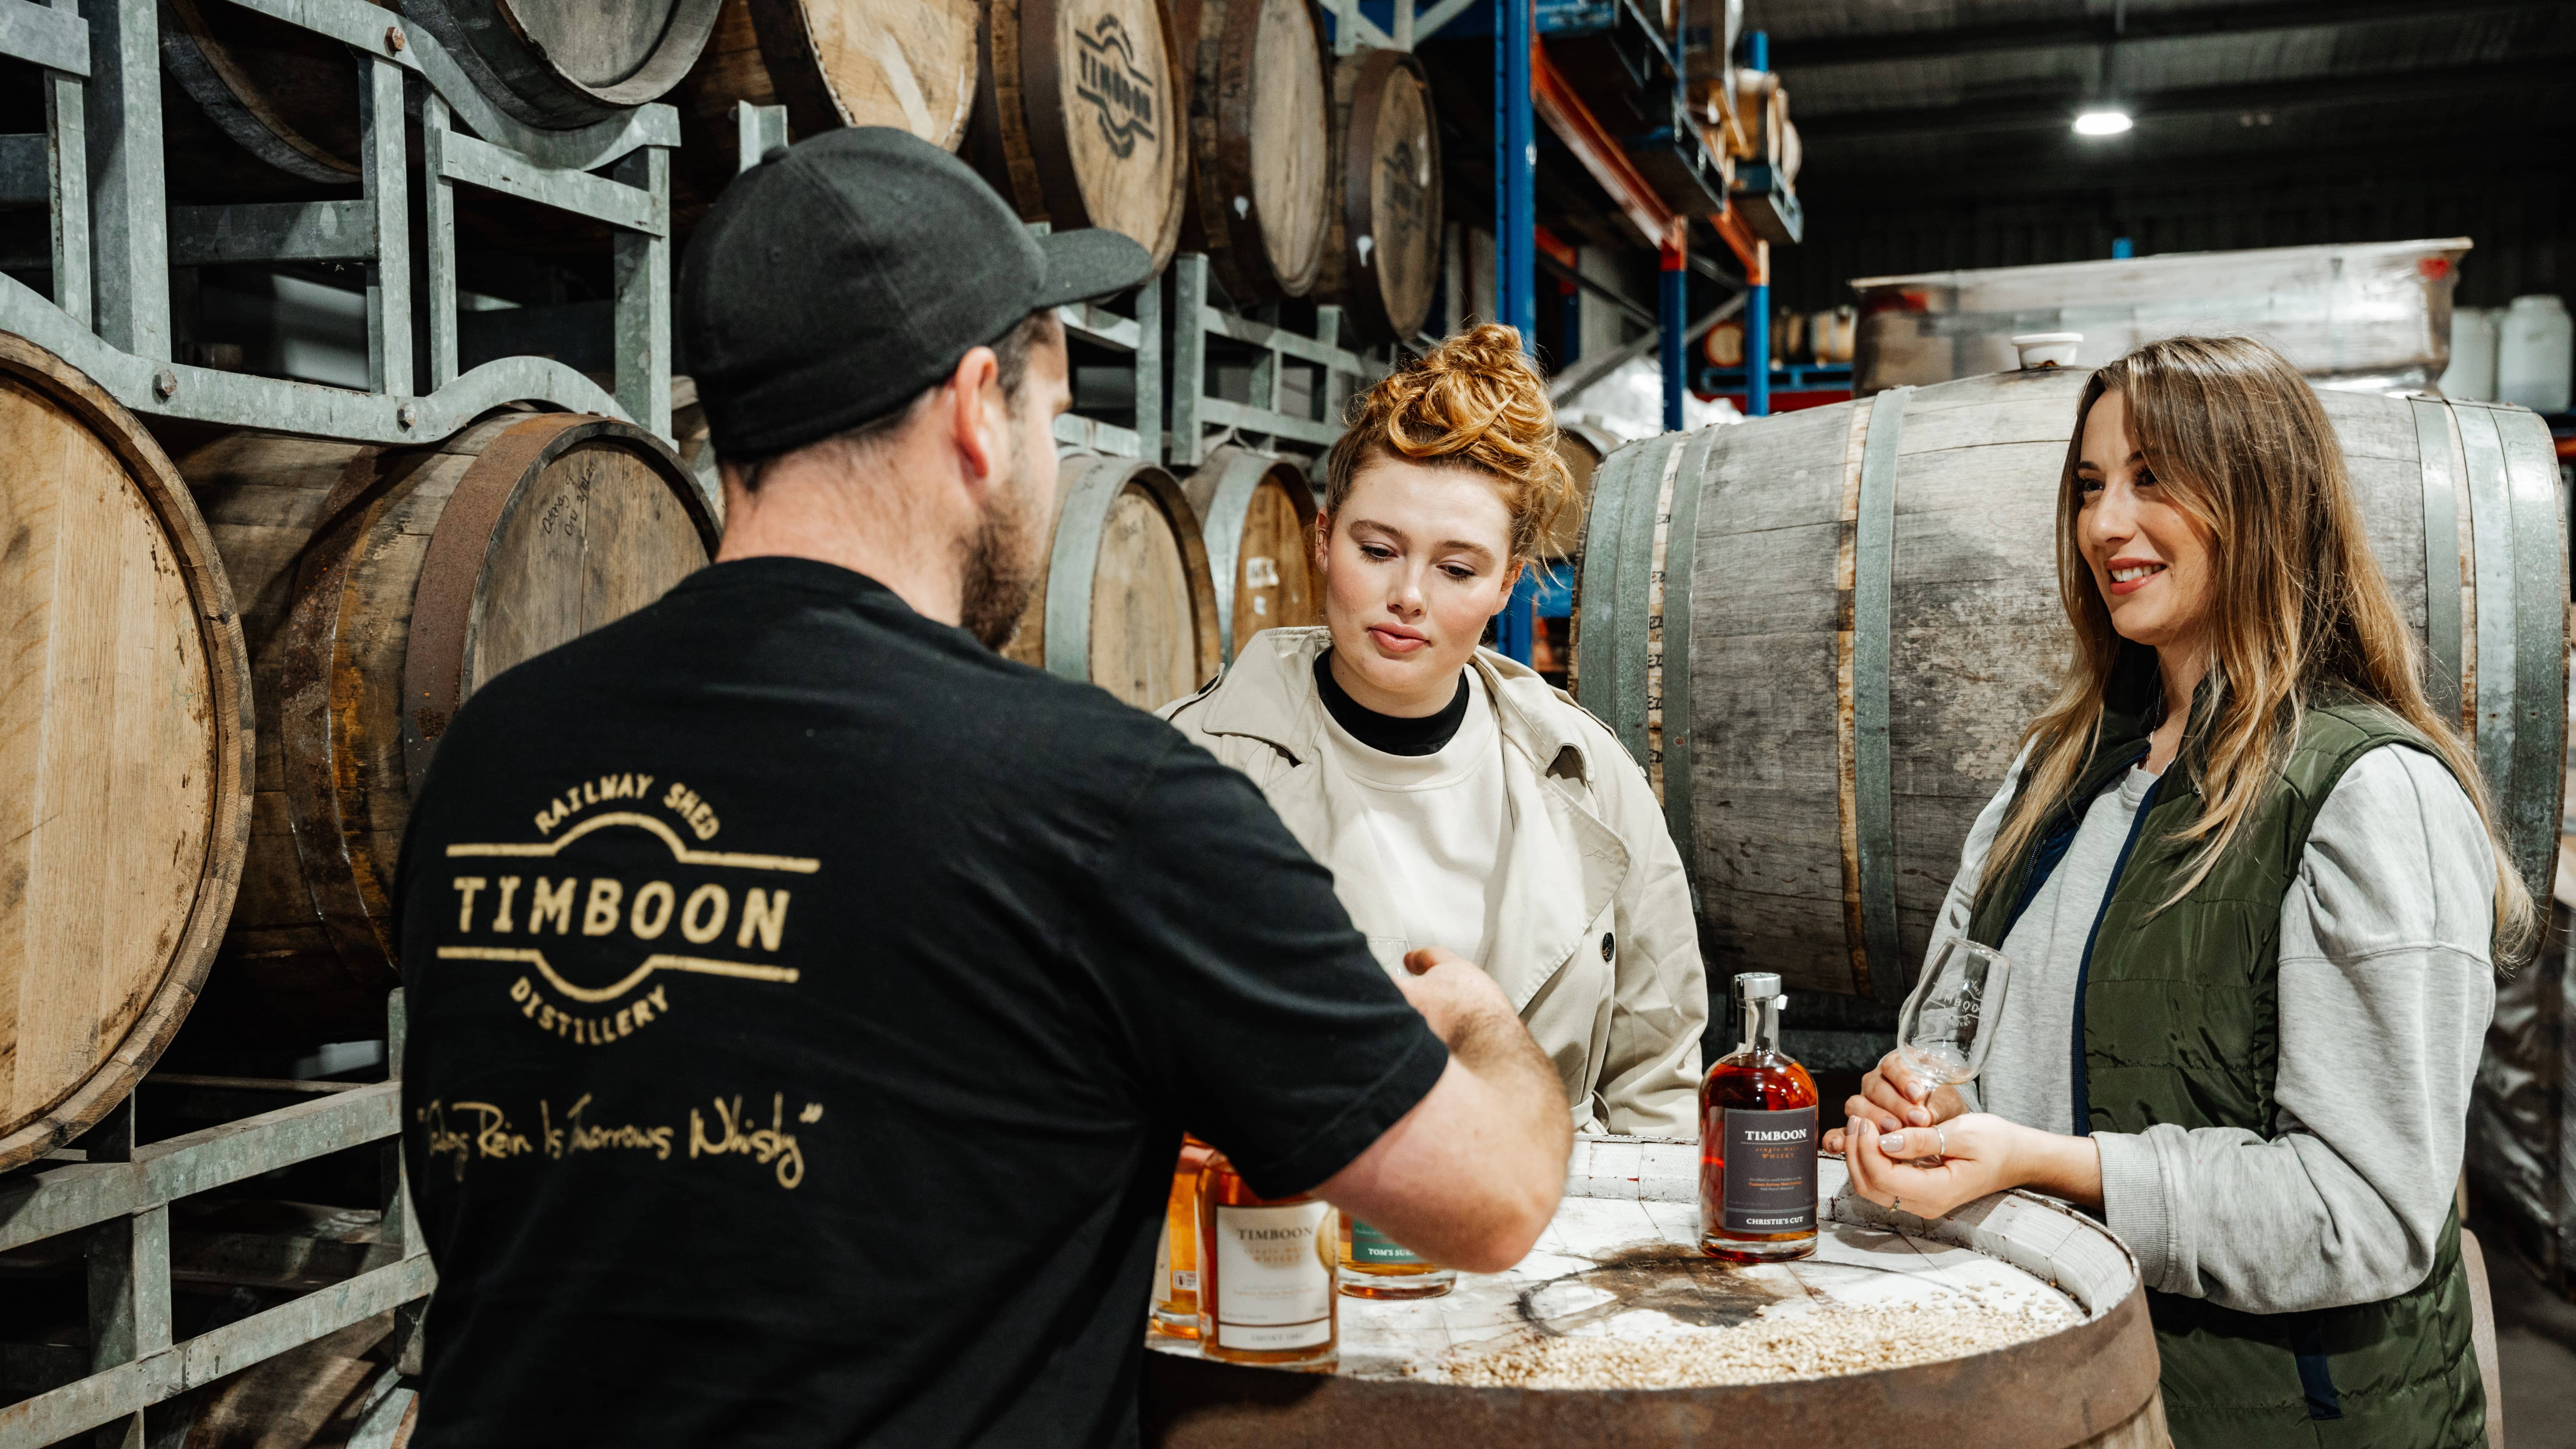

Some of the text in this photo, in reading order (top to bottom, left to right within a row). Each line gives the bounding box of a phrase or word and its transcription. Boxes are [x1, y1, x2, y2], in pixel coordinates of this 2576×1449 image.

[534, 773, 721, 841] RAILWAY SHED
[454, 876, 791, 952] TIMBOON
[510, 976, 670, 1045] DISTILLERY
[1745, 1128, 1807, 1141] TIMBOON
[1789, 1216, 1803, 1224] CUT
[1237, 1227, 1312, 1240] TIMBOON
[1368, 1248, 1393, 1256] TOM'S
